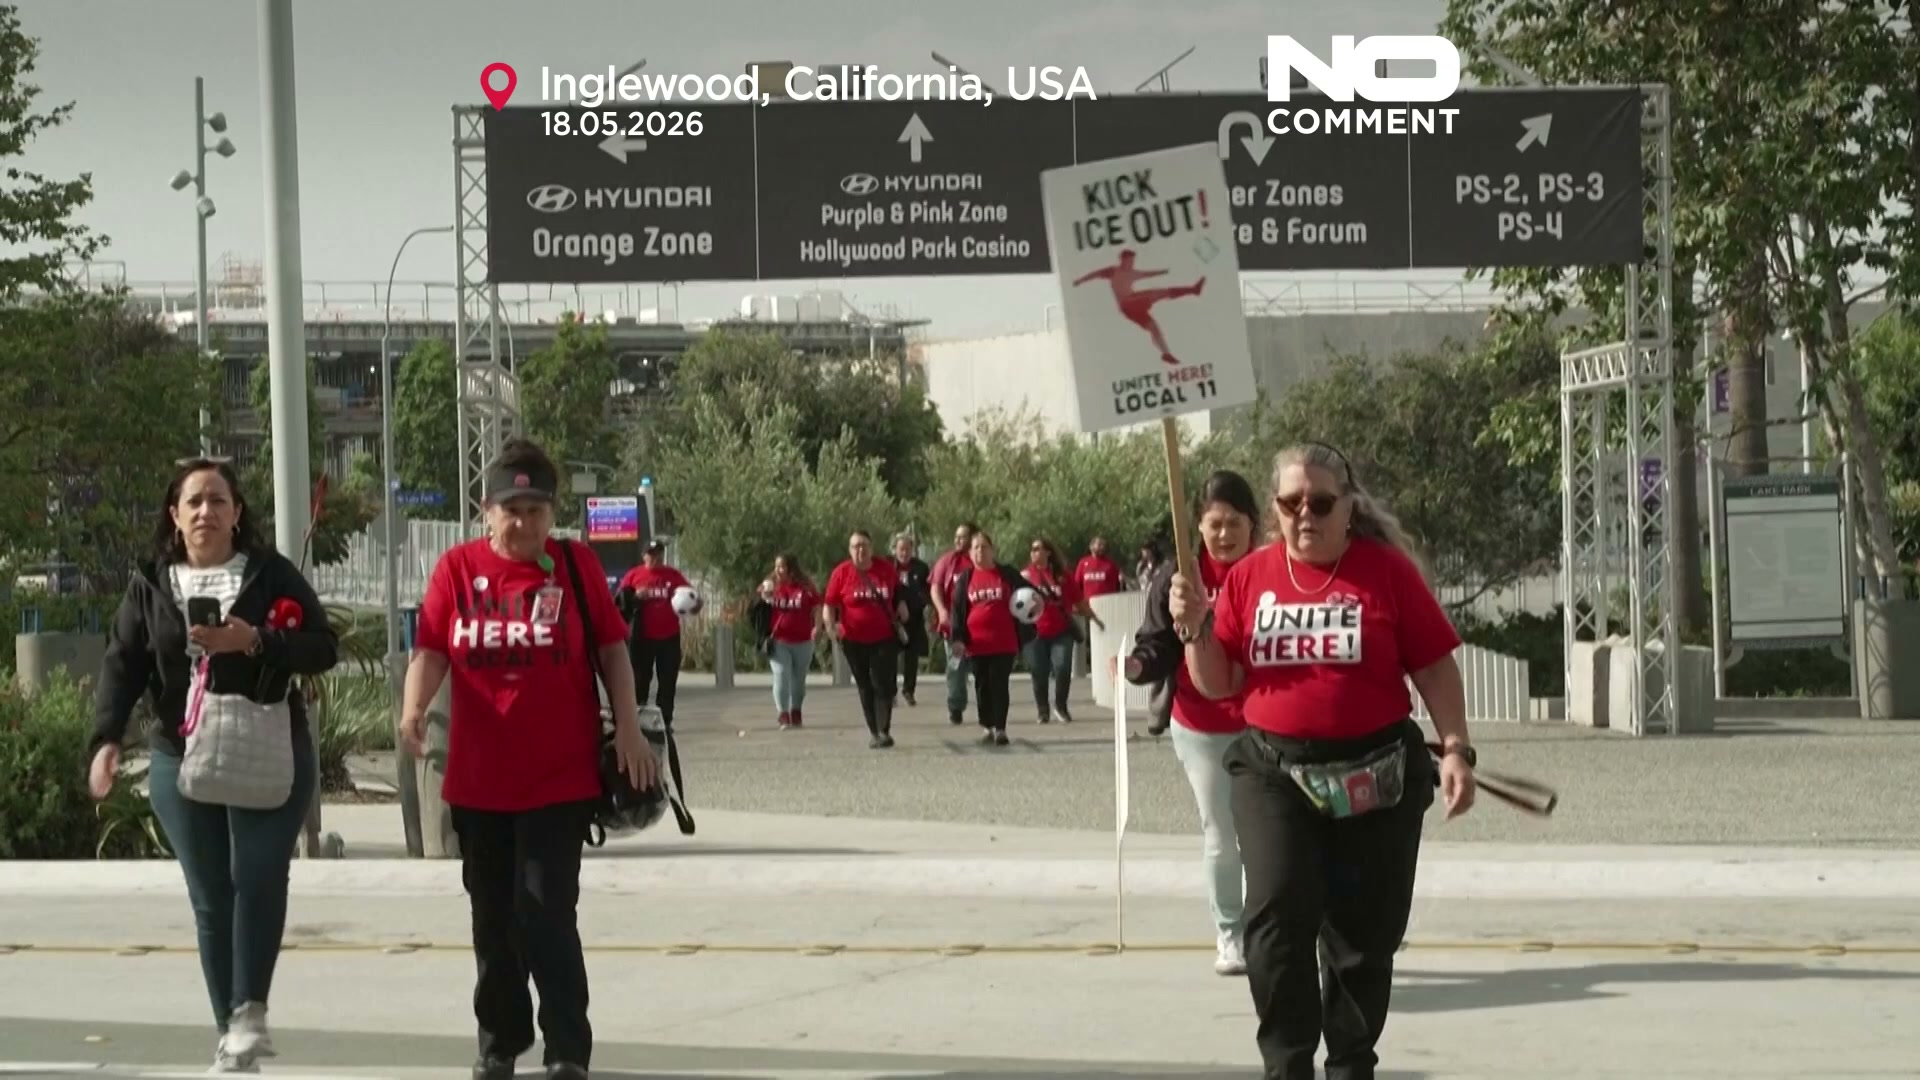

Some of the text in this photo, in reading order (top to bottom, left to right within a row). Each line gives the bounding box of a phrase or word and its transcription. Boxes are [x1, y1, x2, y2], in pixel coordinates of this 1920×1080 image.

[584, 186, 712, 209] HYUNDAI
[884, 174, 982, 192] HYUNDAI
[1083, 169, 1157, 213] KICK
[1265, 179, 1344, 206] Zones
[1455, 172, 1604, 205] PS-2, PS-3
[821, 199, 1008, 231] Purple & Pink Zone
[1074, 189, 1209, 250] ICE OUT!
[1498, 211, 1563, 241] PS-4
[532, 226, 713, 266] Orange Zone
[1261, 217, 1279, 245] &
[1287, 217, 1367, 244] Forum
[800, 234, 1031, 268] Hollywood Park Casino
[1112, 373, 1161, 395] UNITE
[1114, 380, 1216, 415] LOCAL 11
[1257, 606, 1359, 632] UNITE
